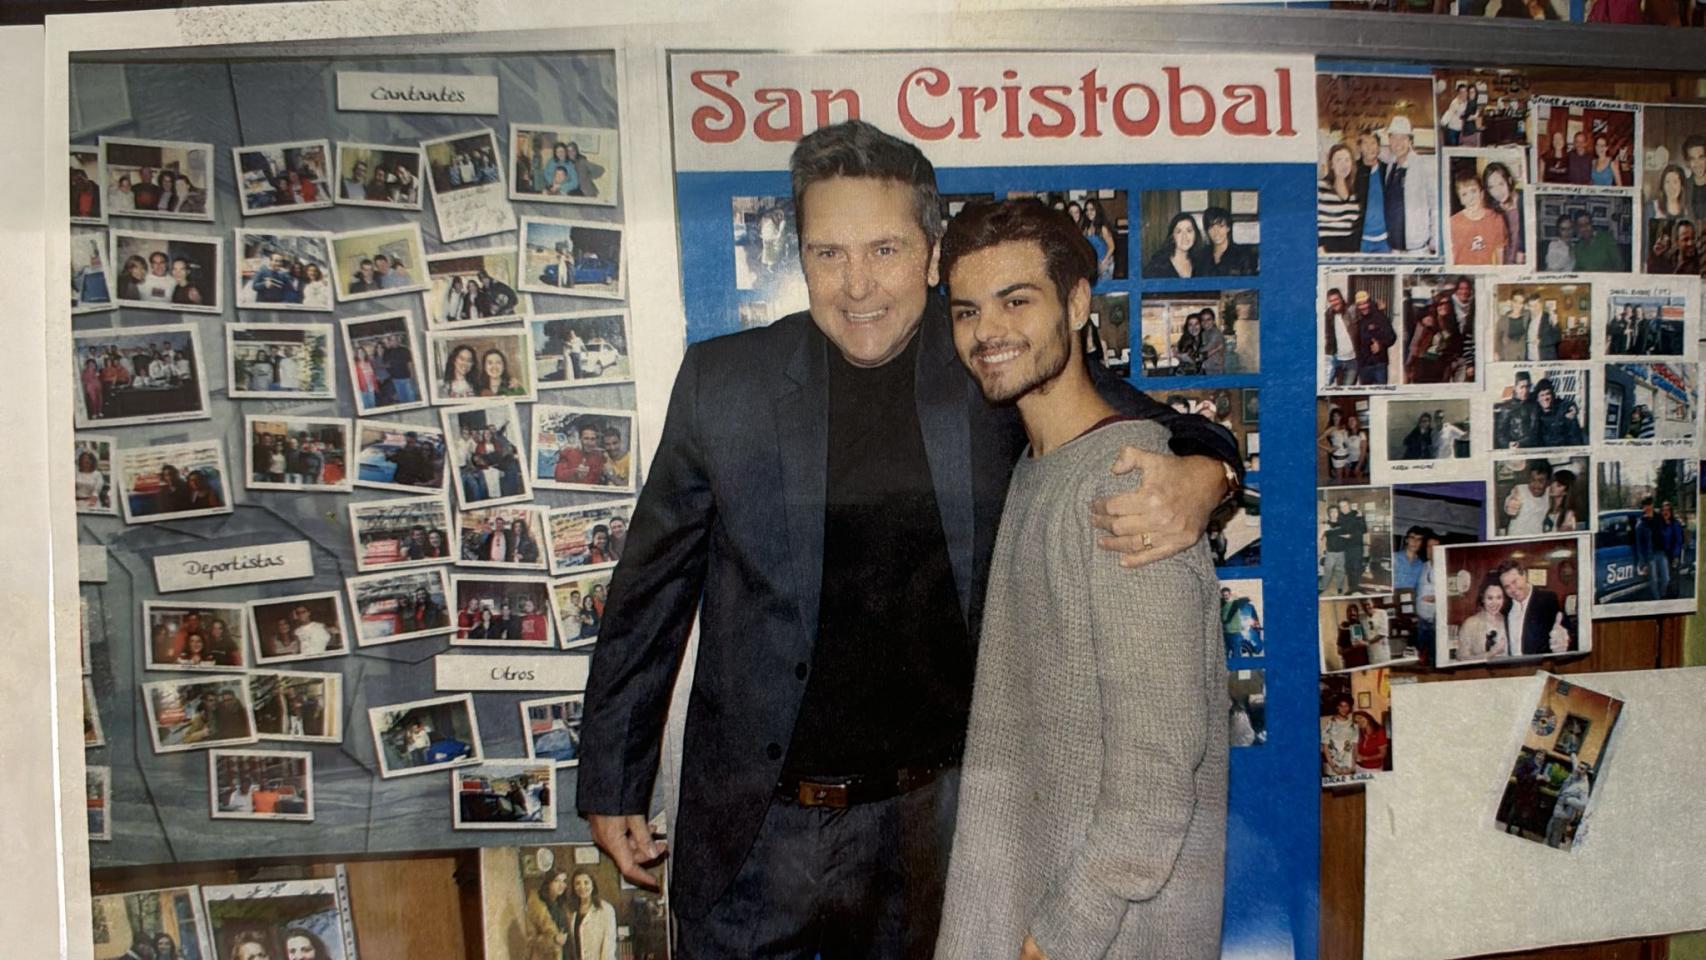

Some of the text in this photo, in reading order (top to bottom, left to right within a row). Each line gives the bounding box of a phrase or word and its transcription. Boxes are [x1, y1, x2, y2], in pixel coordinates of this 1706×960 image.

[370, 84, 466, 104] Cantantes
[690, 70, 861, 143] San
[897, 66, 1298, 141] Cristobal
[183, 553, 286, 580] Deportistas
[1607, 562, 1634, 584] San
[491, 665, 535, 681] Otros
